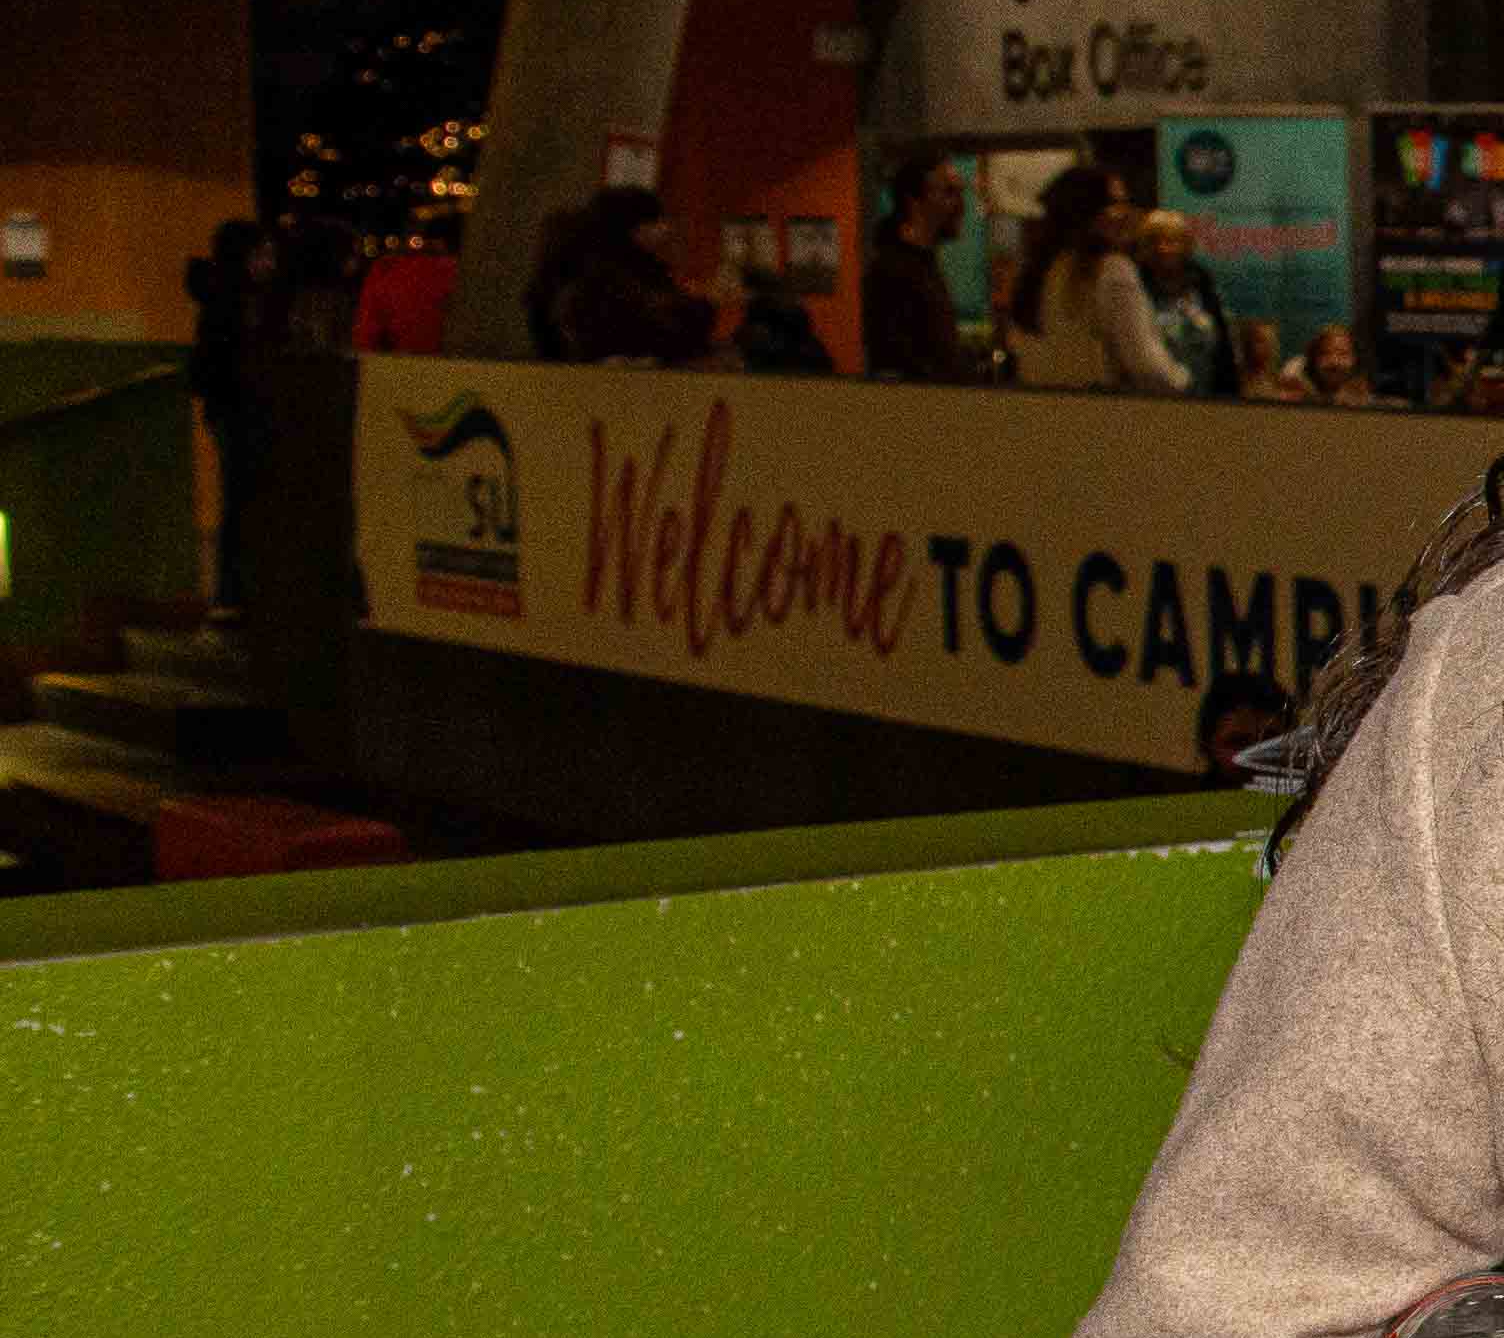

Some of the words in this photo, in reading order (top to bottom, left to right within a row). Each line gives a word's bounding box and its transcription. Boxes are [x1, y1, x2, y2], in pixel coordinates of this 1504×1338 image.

[1003, 28, 1076, 103] Box
[1088, 21, 1210, 98] Office
[582, 399, 918, 658] Welcome
[928, 534, 1037, 664] TO
[1072, 551, 1408, 693] CAMP
